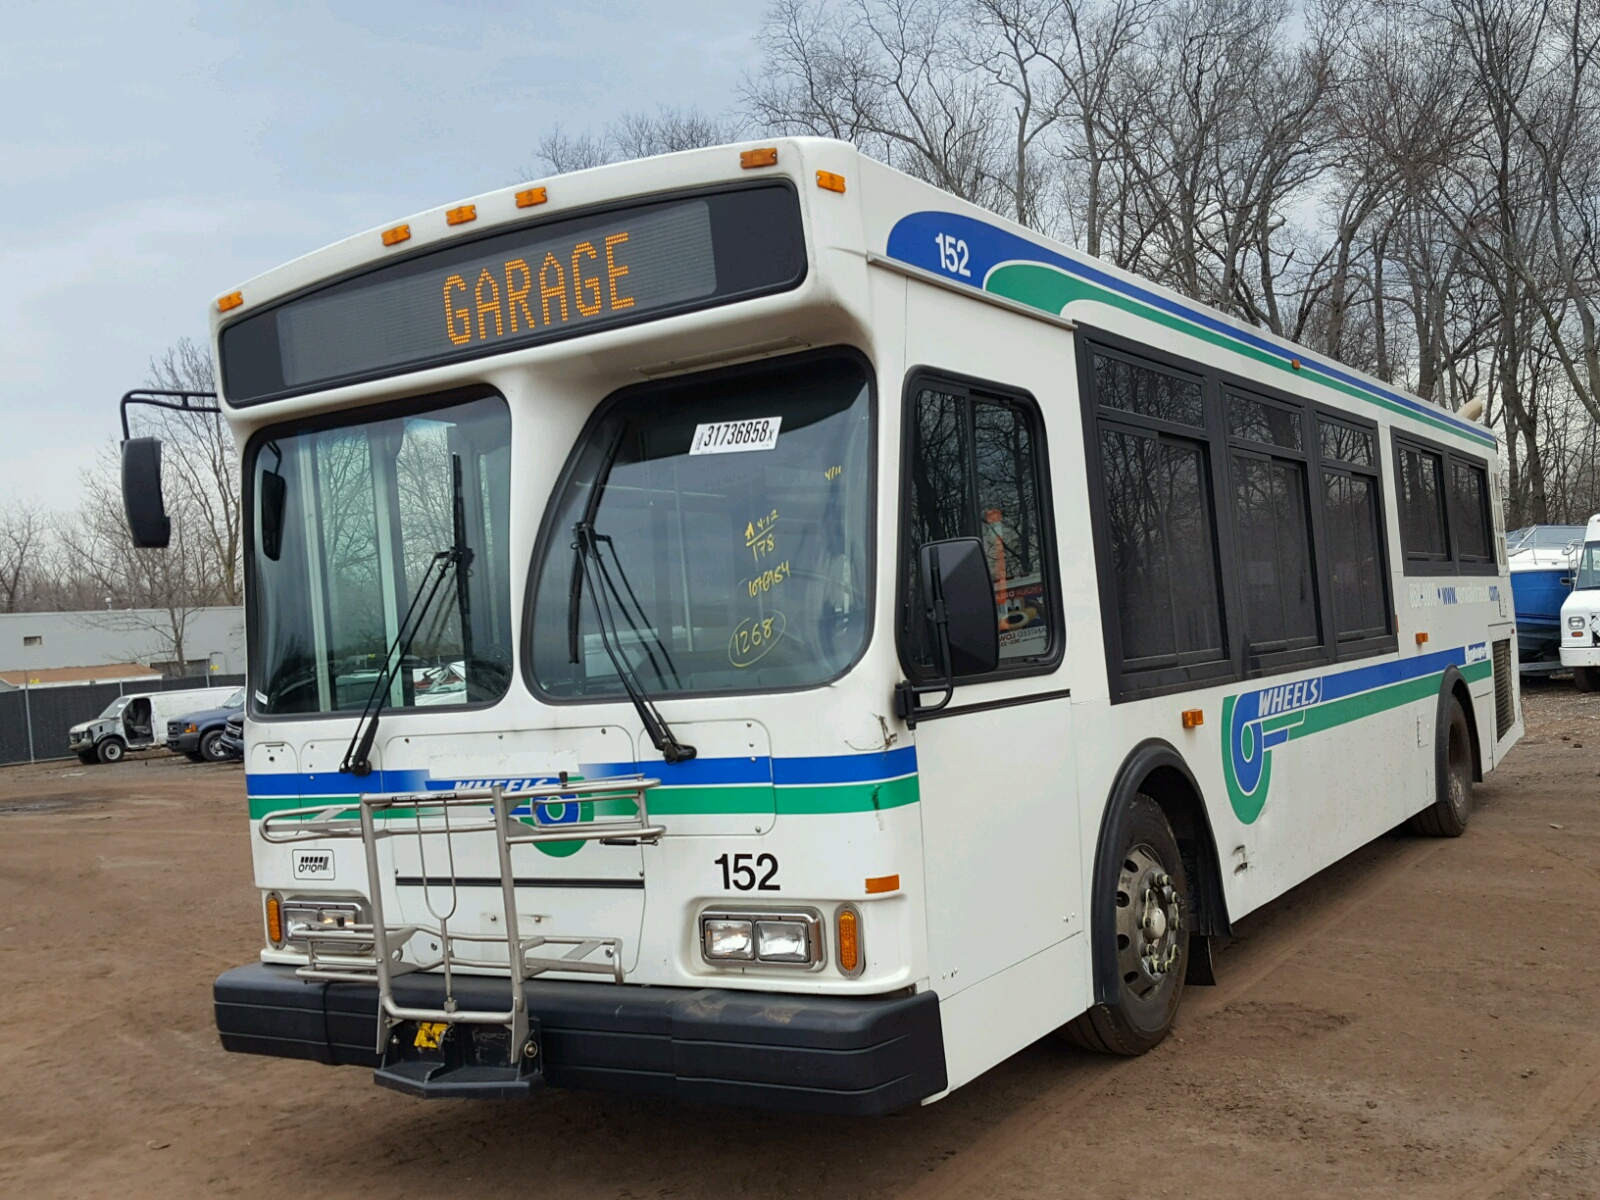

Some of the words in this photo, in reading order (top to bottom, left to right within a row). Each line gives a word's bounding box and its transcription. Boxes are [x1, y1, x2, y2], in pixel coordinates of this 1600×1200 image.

[934, 232, 971, 277] 152
[443, 236, 635, 345] GARAGE
[734, 616, 776, 656] 1268
[1257, 678, 1319, 718] WHEELS
[714, 853, 781, 891] 152
